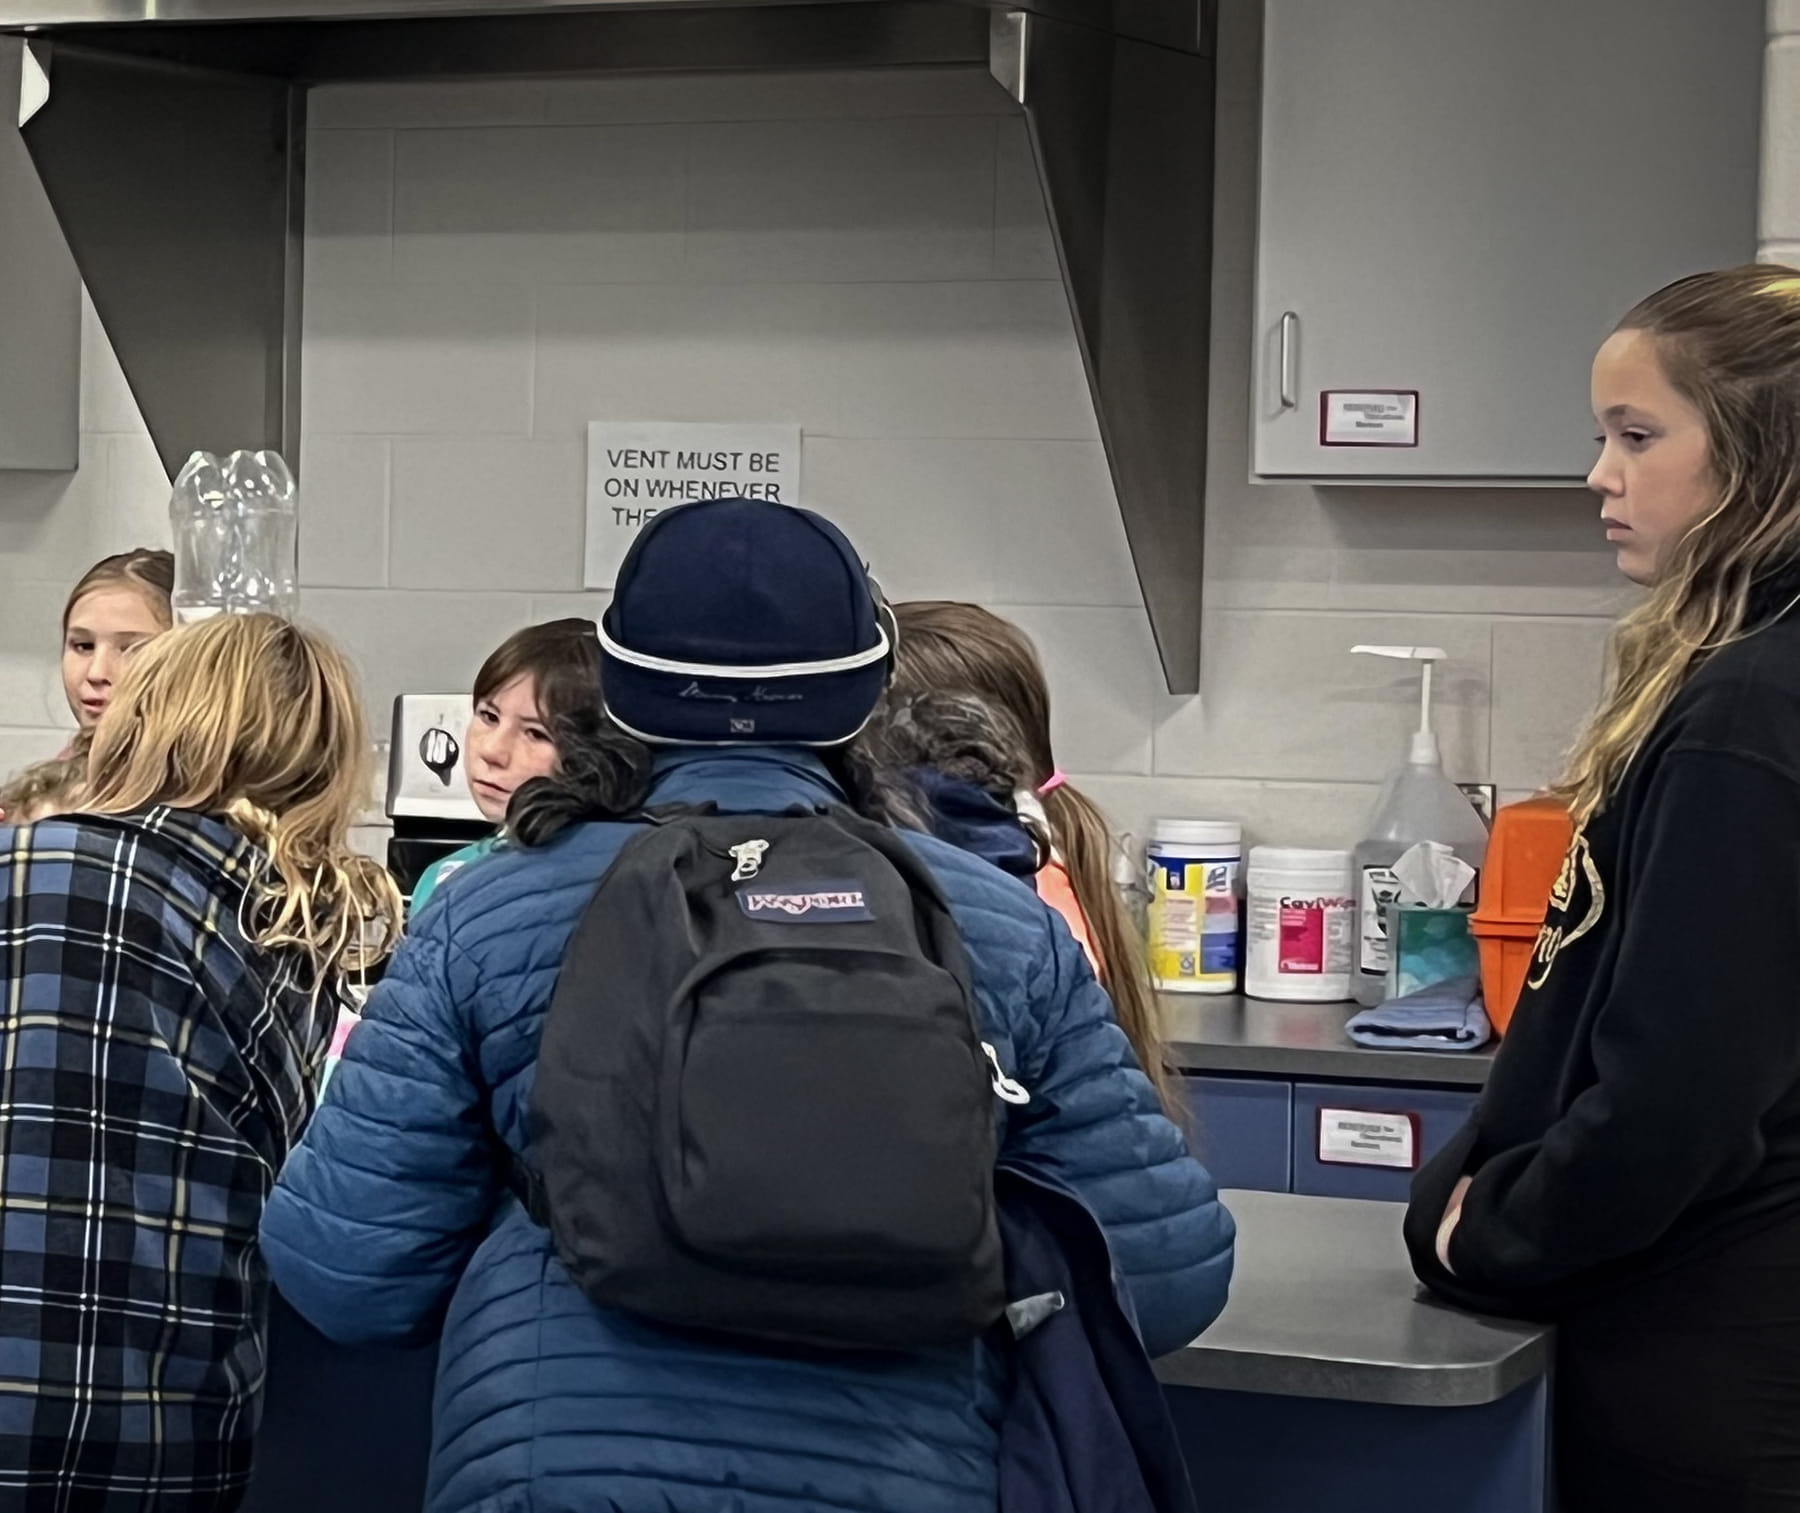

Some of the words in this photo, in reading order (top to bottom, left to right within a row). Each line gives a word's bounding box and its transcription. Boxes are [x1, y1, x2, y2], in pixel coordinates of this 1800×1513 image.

[607, 449, 670, 469] VENT
[677, 451, 743, 471] MUST
[749, 452, 780, 473] BE
[604, 478, 639, 498] ON
[646, 479, 780, 503] WHENEVER
